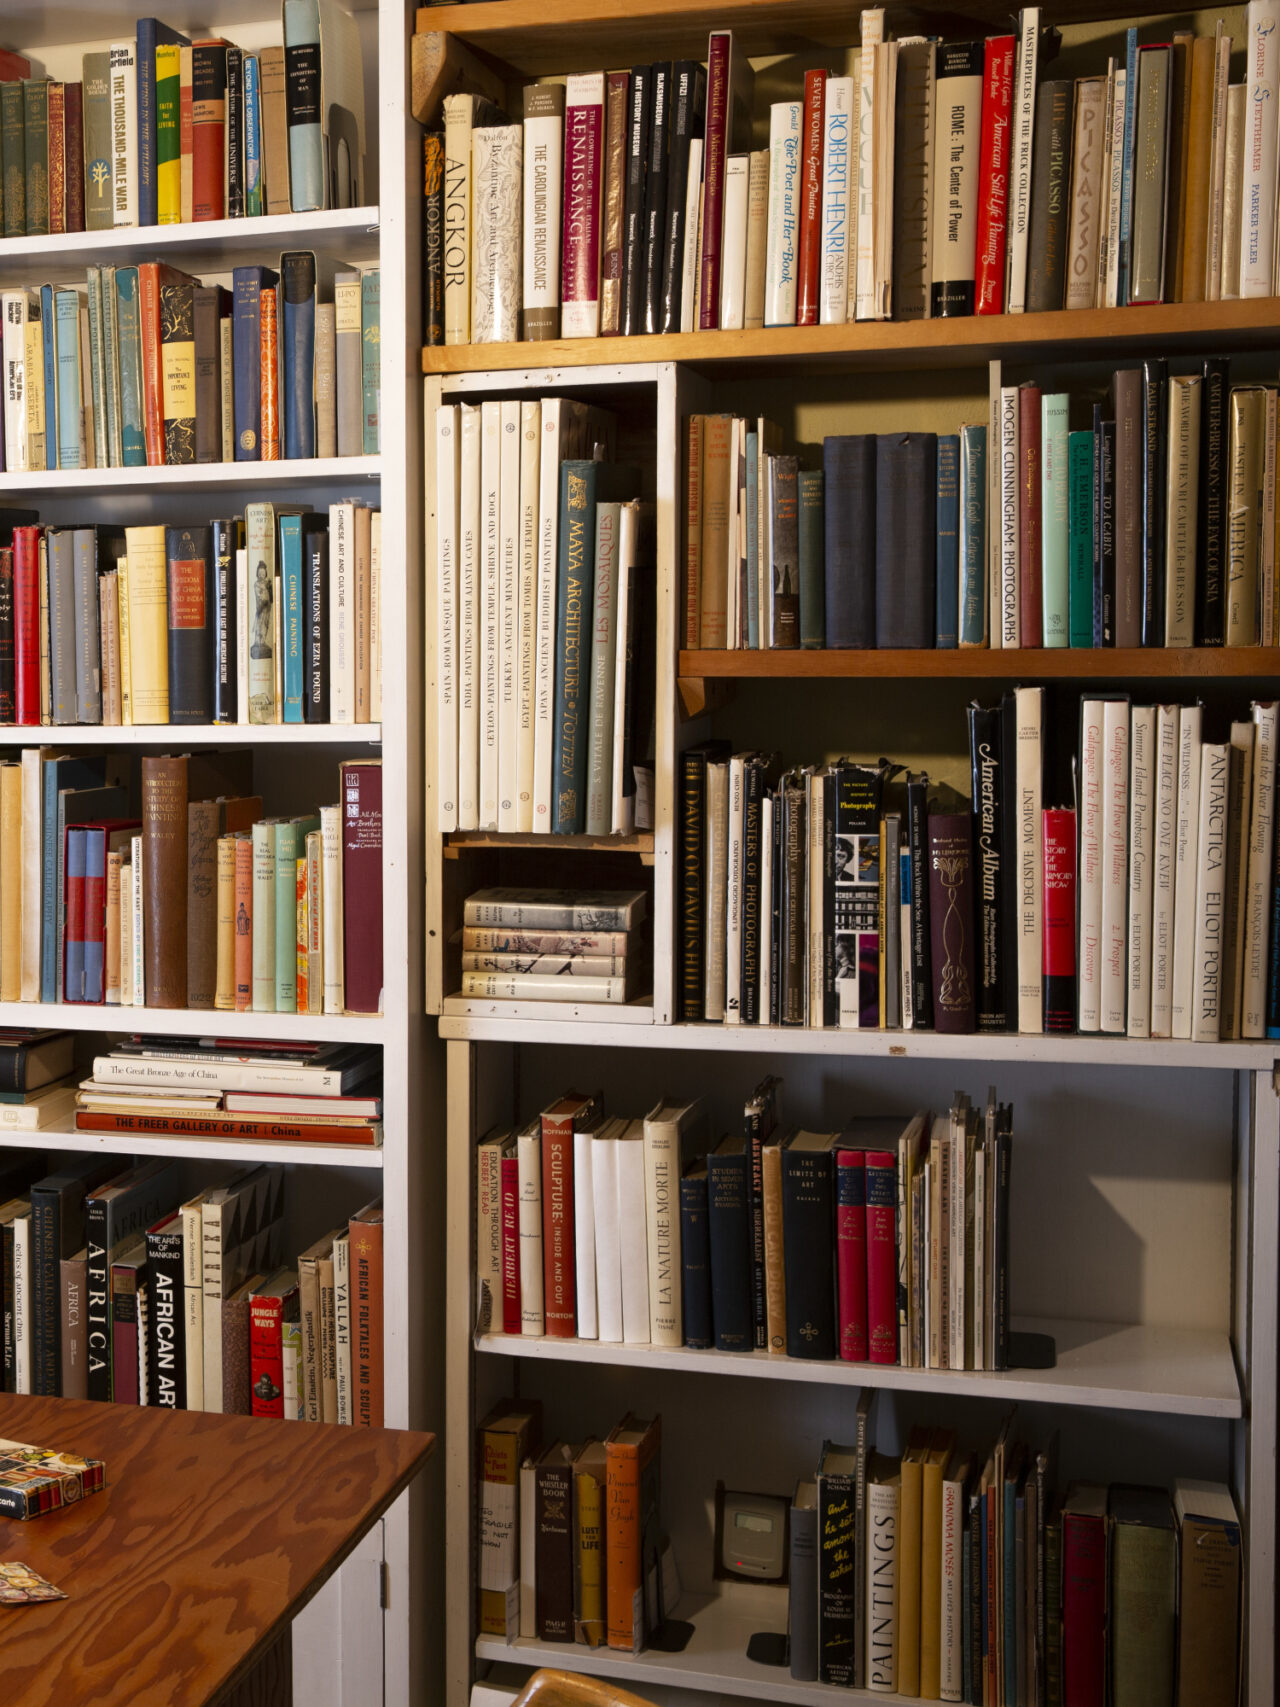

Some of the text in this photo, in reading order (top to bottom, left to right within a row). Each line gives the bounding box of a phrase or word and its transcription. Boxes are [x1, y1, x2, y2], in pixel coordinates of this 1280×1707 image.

[111, 49, 128, 58] Brian
[159, 102, 173, 110] FAITH
[159, 120, 175, 128] LIVING
[246, 108, 254, 157] OBSERVATORY
[1017, 26, 1035, 234] MASTERPIECES OF THE FRICK COLLECTION
[113, 75, 127, 211] THE THOUSAND-MILE WAR
[950, 145, 964, 163] The
[992, 113, 1008, 169] American
[1049, 128, 1058, 151] with
[570, 111, 586, 244] RENAISSANCE
[826, 113, 848, 254] ROBERT HENRI
[949, 199, 962, 210] of
[950, 166, 964, 198] Center
[1048, 151, 1064, 215] PICASSO
[1074, 108, 1095, 277] PICASSO
[427, 196, 440, 274] ANGKOR
[446, 158, 466, 289] ANGKOR
[534, 144, 547, 291] THE CAROLINGIAN RENAISSANCE
[949, 212, 962, 243] Power
[982, 221, 1004, 265] Painting
[544, 518, 552, 573] PAINTINGS
[1003, 395, 1016, 642] IMOGEN CUNNINGHAM: PHOTOGRAPHS
[289, 575, 297, 611] CHINESE
[312, 552, 320, 622] TRANSLATIONS
[542, 576, 550, 630] BUDDHIST
[596, 514, 614, 644] LES MOSAIQUES
[313, 626, 320, 638] OF
[540, 634, 549, 681] ANCIENT
[562, 520, 584, 778] MAYA ARCHITECTURE TOTTEN
[840, 802, 876, 812] Photography
[979, 743, 999, 900] American Album
[1023, 788, 1034, 936] THE DECISIVE MOMENT
[1201, 751, 1227, 1021] ANTARCTICA ELIOT PORTER
[746, 802, 757, 984] MASTERS OF PHOTOGRAPHY
[111, 1065, 218, 1080] The Great Bronze Age of China
[116, 1117, 301, 1137] THE FREER GALLERY OF ART China
[504, 1192, 516, 1299] HERBERT READ
[655, 1161, 671, 1306] LA NATURE MORTE
[89, 1242, 106, 1373] AFRICA
[156, 1273, 175, 1369] AFRICAN
[251, 1307, 278, 1317] JUNGLE
[254, 1318, 275, 1327] WAYS
[337, 1284, 348, 1344] YALLAH
[304, 1311, 313, 1363] Negerplastik
[309, 1398, 317, 1421] Carl
[0, 1498, 16, 1508] carte
[539, 1480, 568, 1489] WHISTLER
[543, 1489, 565, 1497] BOOK
[582, 1526, 599, 1535] LUST
[582, 1541, 600, 1550] LIFE
[945, 1486, 955, 1577] GRANDMA MOSES
[871, 1515, 895, 1687] PAINTINGS
